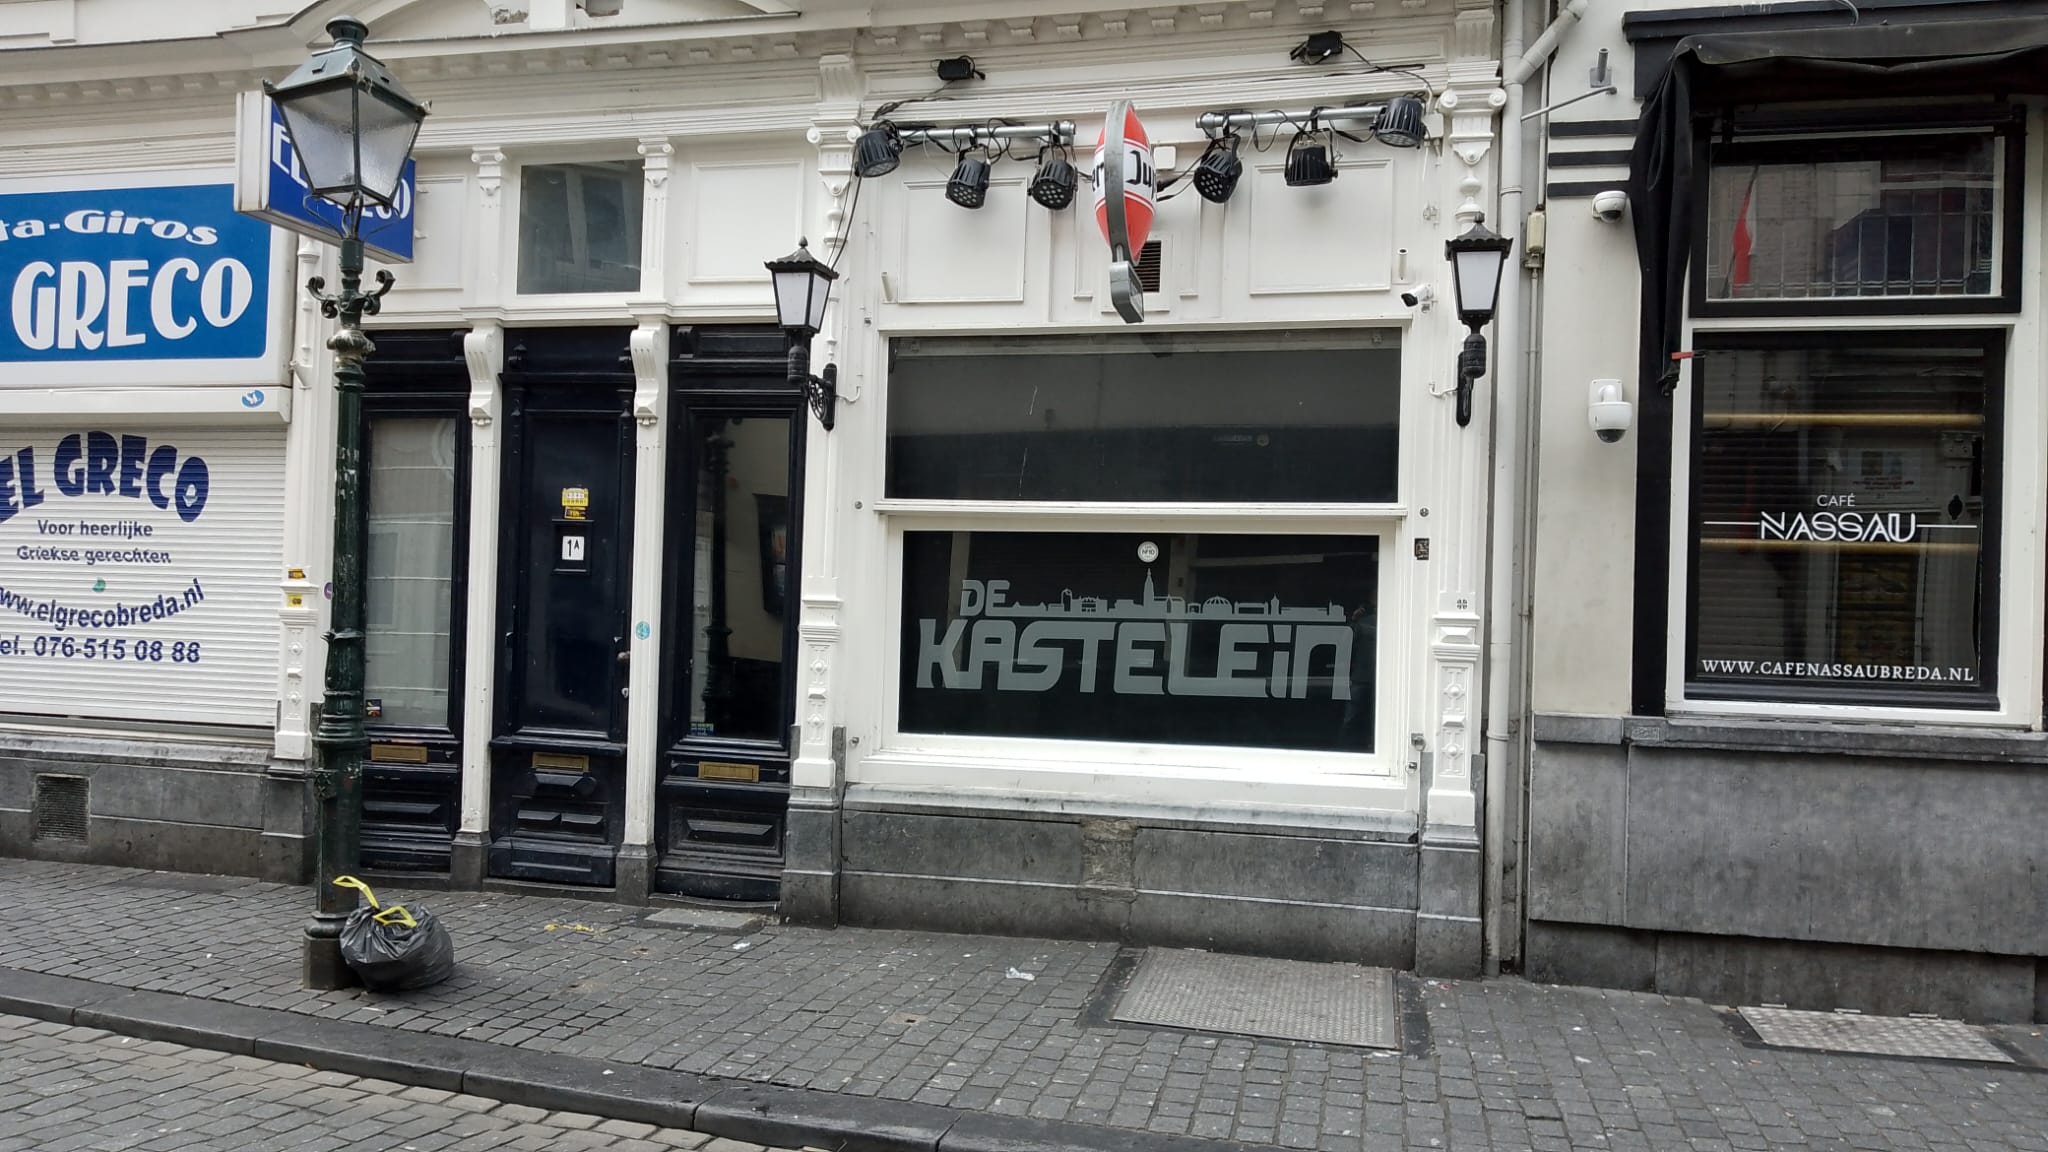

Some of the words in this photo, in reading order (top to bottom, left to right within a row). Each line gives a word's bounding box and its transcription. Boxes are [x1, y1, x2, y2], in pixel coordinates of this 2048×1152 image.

[11, 257, 253, 350] GRECO
[54, 430, 209, 522] GRECO
[1816, 493, 1856, 507] CAFÉ
[37, 520, 75, 535] Voor
[80, 520, 153, 539] heerlijke
[1761, 511, 1916, 542] NASSAU
[16, 545, 80, 562] Griekse
[84, 547, 172, 566] gerechten
[566, 538, 580, 557] 1A
[0, 577, 205, 631] ww.elgrecobreda.nl
[959, 579, 1010, 617] DE
[0, 633, 26, 656] el.
[33, 635, 127, 660] 076-515
[134, 639, 164, 663] 08
[172, 641, 201, 664] 88
[1702, 659, 1974, 681] WWW.CAFENASSAUBREDA.NL
